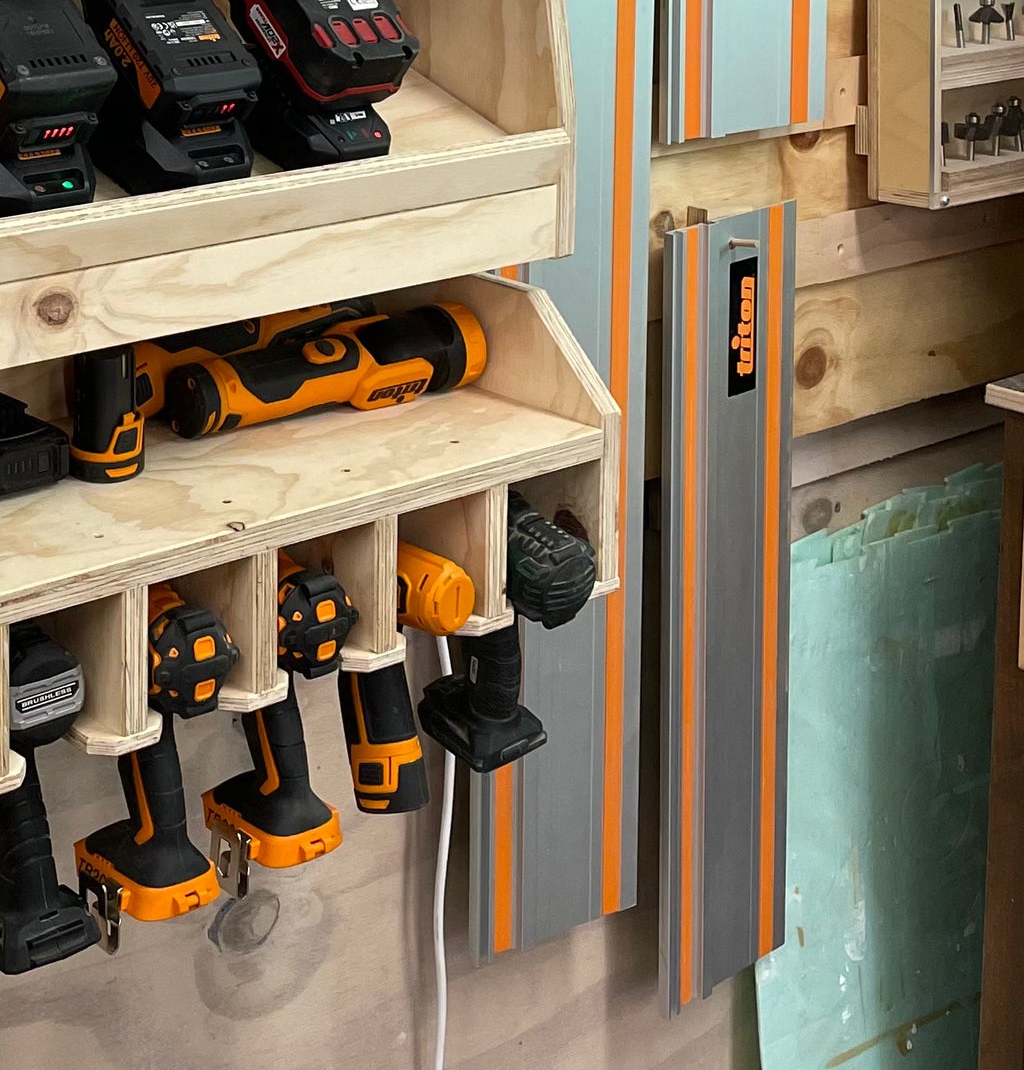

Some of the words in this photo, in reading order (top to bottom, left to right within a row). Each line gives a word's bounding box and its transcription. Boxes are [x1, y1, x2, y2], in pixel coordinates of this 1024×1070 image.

[104, 29, 132, 68] 2.0Ah
[731, 276, 755, 377] triton
[366, 377, 430, 404] triton
[20, 686, 73, 709] BRUSHLESS
